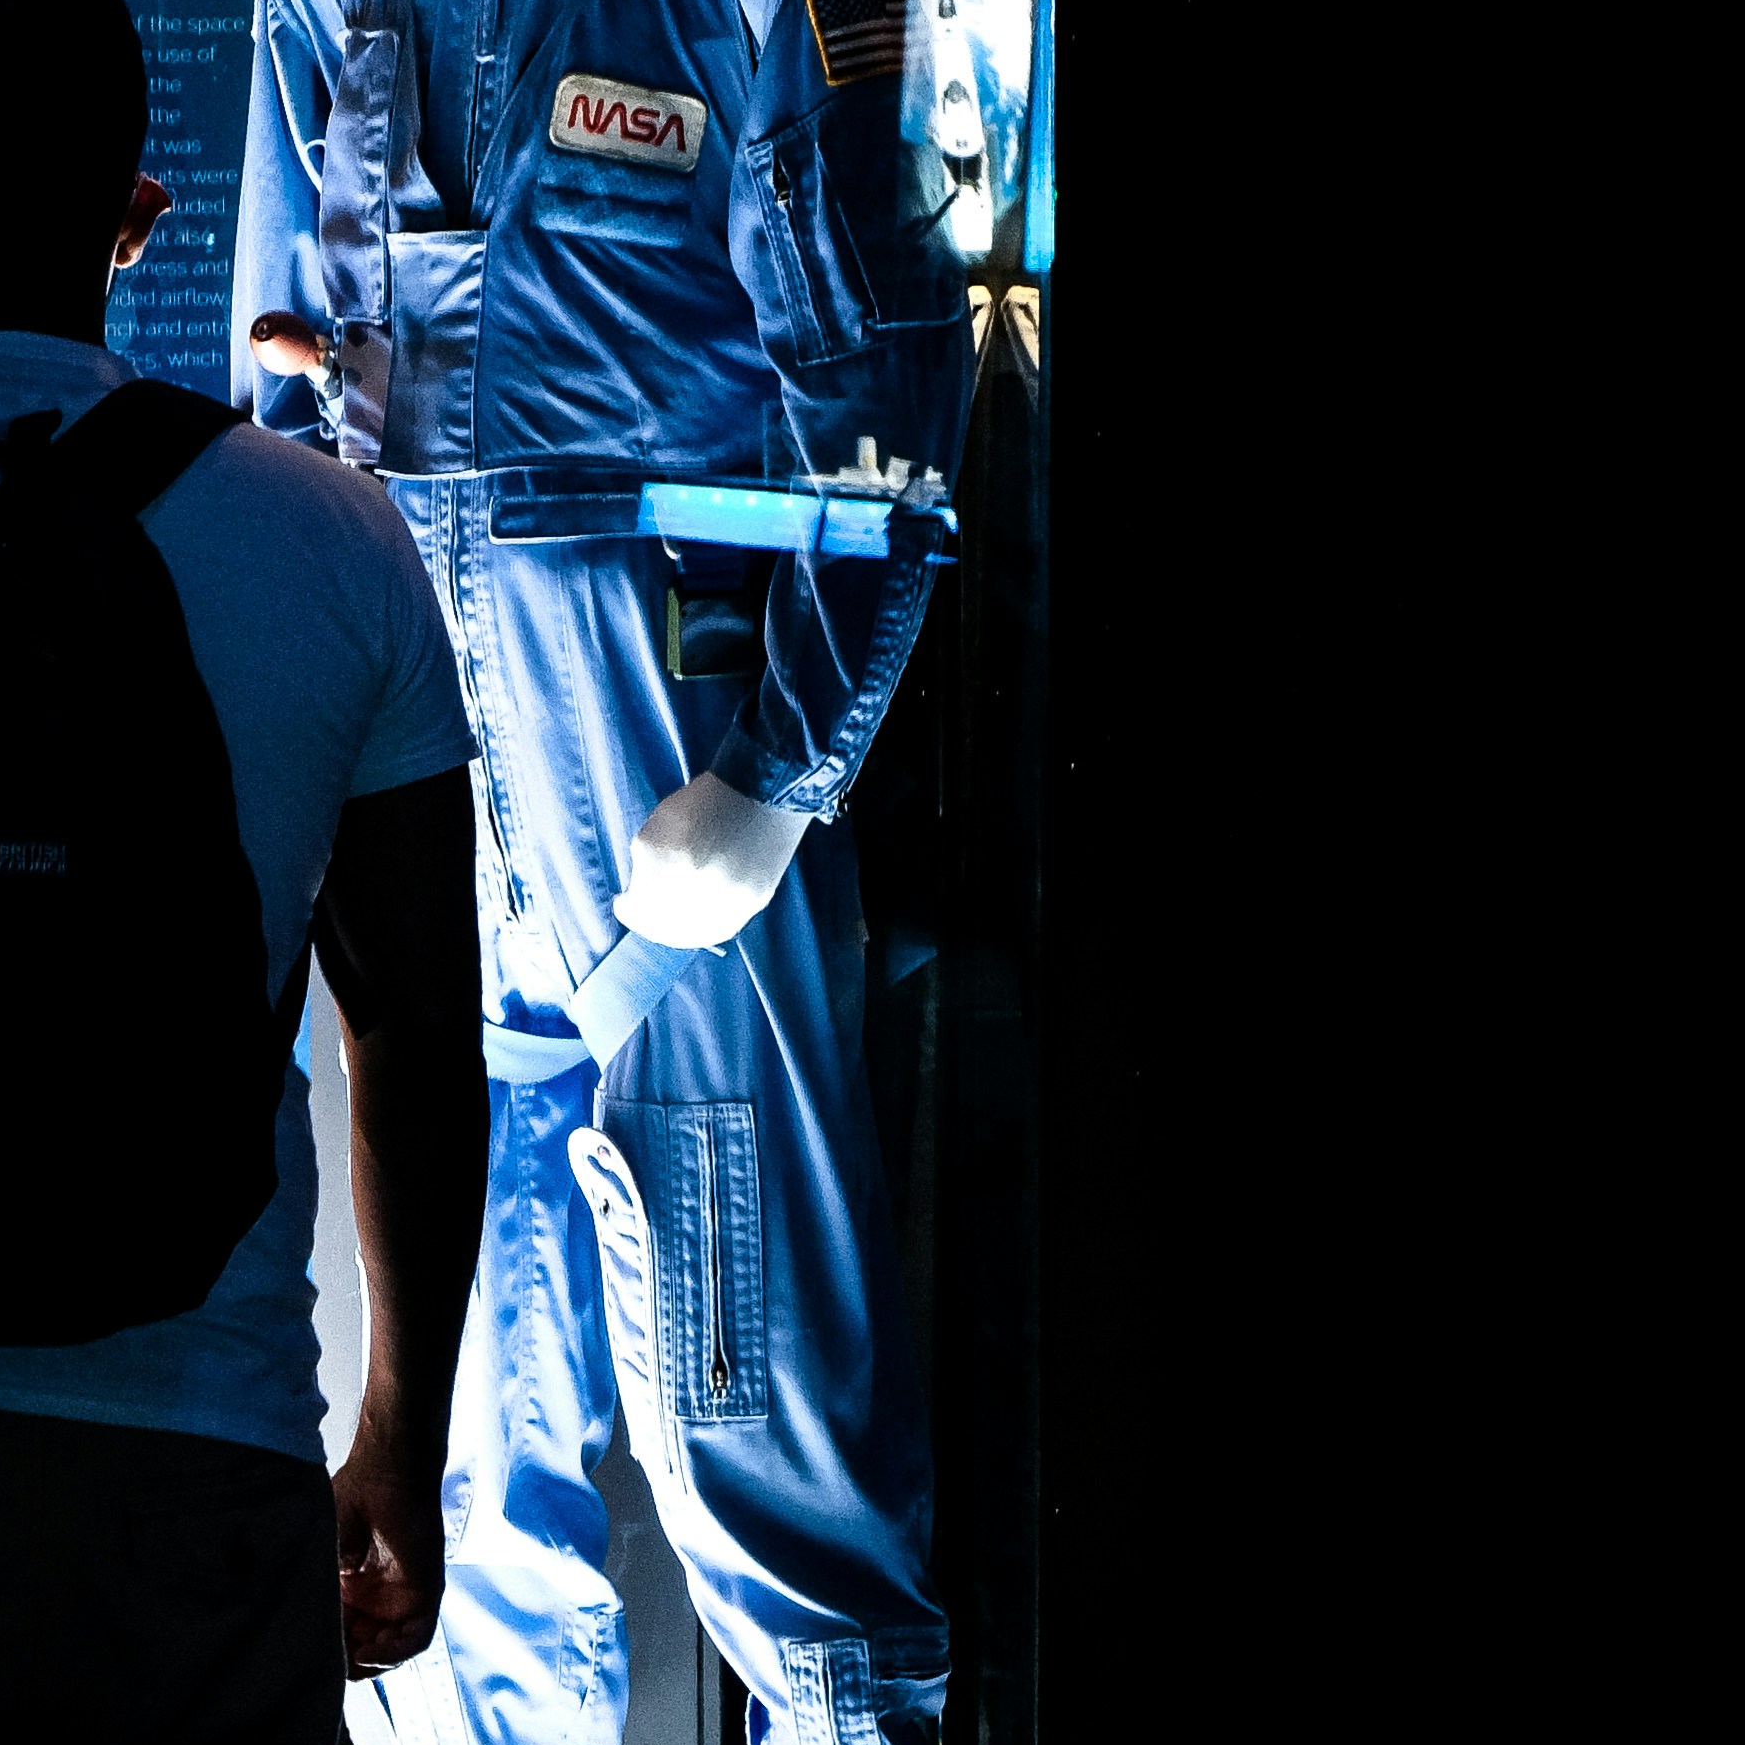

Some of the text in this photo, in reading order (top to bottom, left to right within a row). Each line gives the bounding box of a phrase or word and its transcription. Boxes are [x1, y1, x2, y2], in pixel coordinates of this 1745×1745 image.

[150, 15, 182, 33] the
[187, 17, 245, 36] space
[157, 48, 193, 64] use
[197, 44, 218, 63] of
[150, 76, 182, 94] the
[150, 106, 182, 125] the
[567, 93, 687, 153] NASA
[162, 138, 202, 155] was
[191, 169, 239, 185] were
[172, 196, 225, 214] luded
[192, 257, 230, 276] and
[104, 319, 140, 338] nch
[145, 318, 182, 336] and
[167, 349, 224, 367] which
